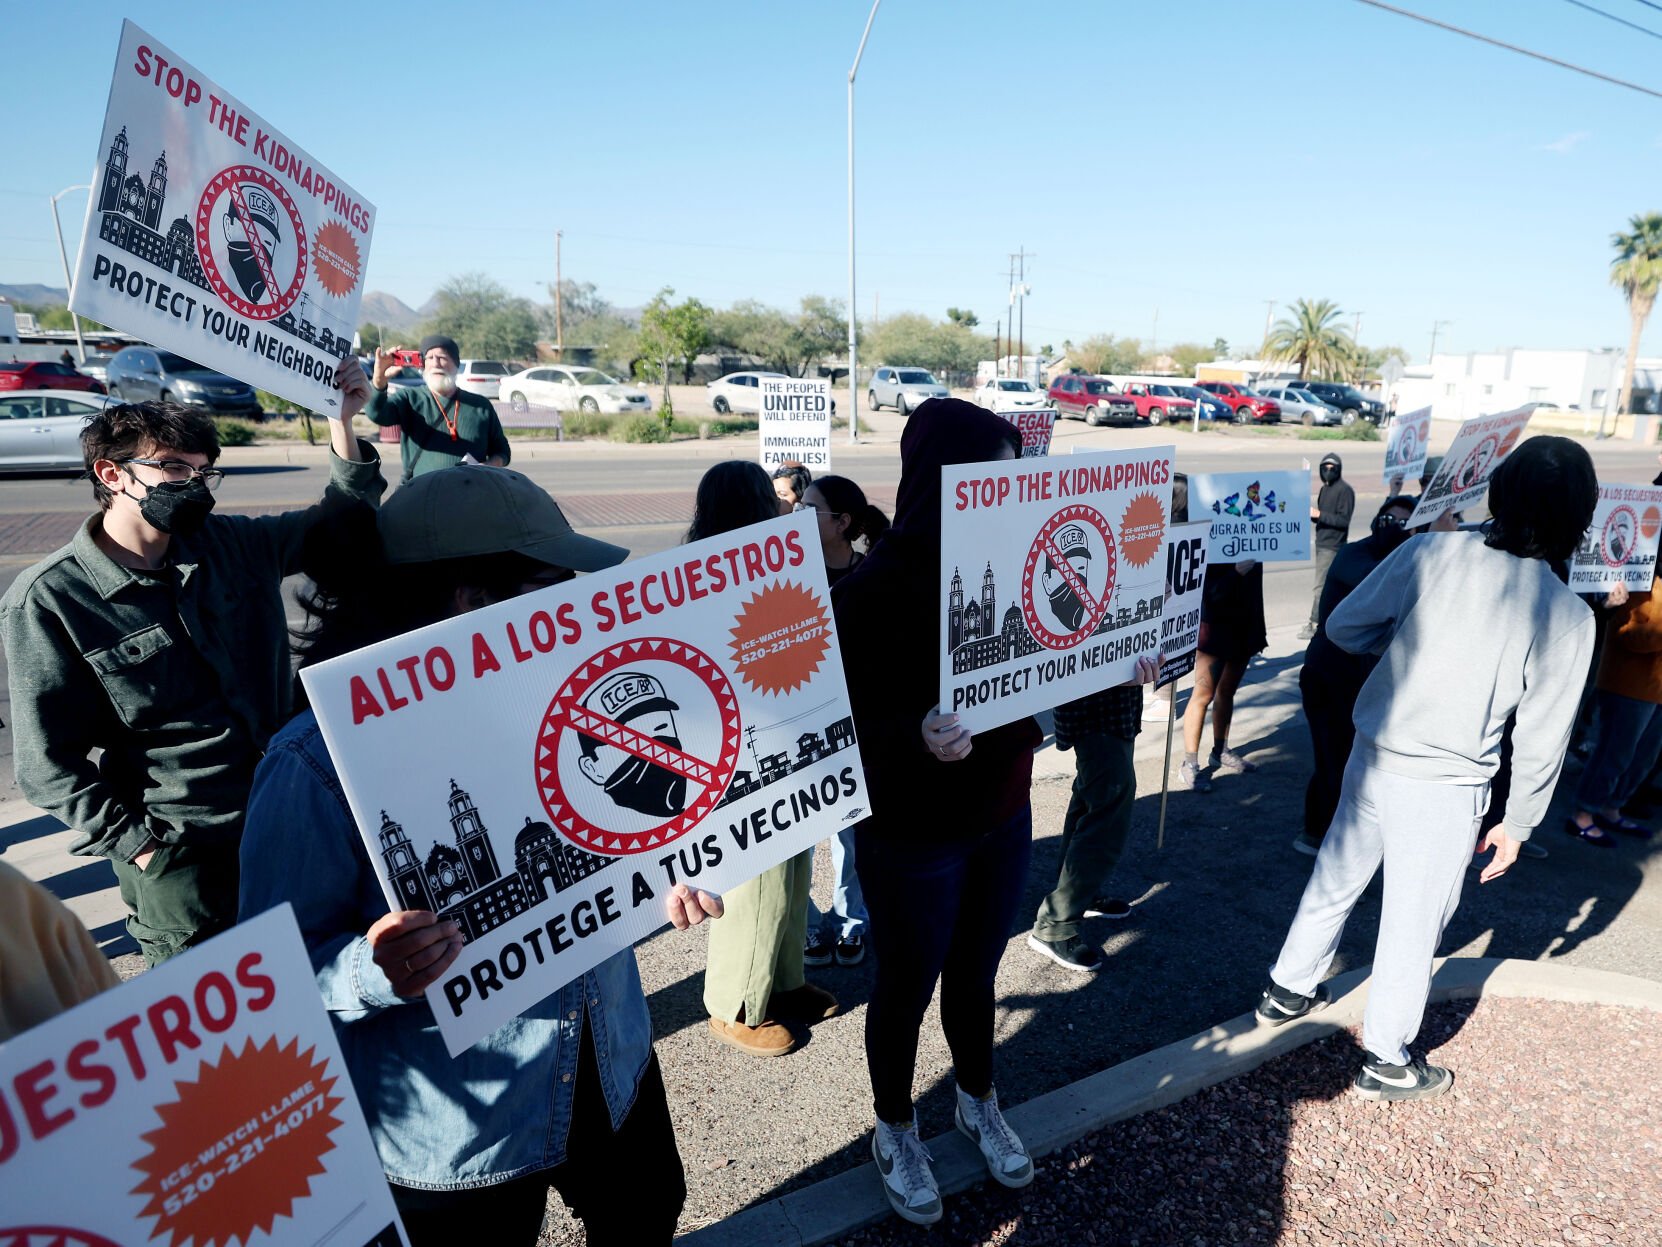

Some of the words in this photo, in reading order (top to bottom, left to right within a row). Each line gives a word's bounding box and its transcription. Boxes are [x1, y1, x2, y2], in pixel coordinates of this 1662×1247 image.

[134, 45, 201, 108] STOP
[209, 94, 250, 146] THE
[254, 128, 370, 234] KIDNAPPINGS
[93, 253, 196, 323] PROTECT
[202, 303, 249, 349] YOUR
[254, 333, 341, 390] NEIGHBORS
[763, 382, 784, 394] THE
[786, 383, 826, 394] PEOPLE
[764, 395, 826, 412] UNITED
[764, 411, 786, 422] WILL
[789, 411, 827, 422] DEFEND
[764, 436, 827, 448] IMMIGRANT
[764, 451, 827, 465] FAMILIES!
[955, 476, 1010, 512] STOP
[1016, 471, 1053, 503] THE
[1058, 459, 1170, 498] KIDNAPPINGS
[1609, 488, 1622, 499] LOS
[1124, 530, 1161, 543] 520-221-4077
[1251, 522, 1266, 534] NO
[1269, 522, 1282, 534] ES
[1286, 521, 1301, 533] UN
[1221, 536, 1278, 557] DELITO
[1572, 571, 1602, 583] PROTEGE
[1611, 571, 1621, 581] TUS
[1624, 571, 1651, 582] VECINOS
[351, 646, 456, 725] ALTO
[472, 632, 501, 679] A
[506, 603, 582, 663] LOS
[591, 529, 806, 633] SECUESTROS
[741, 627, 789, 651] ICE-WATCH
[790, 615, 819, 632] LLAME
[1176, 613, 1187, 634] OF
[1187, 608, 1200, 629] OUR
[741, 625, 823, 665] 520-221-4077
[953, 667, 1032, 713] PROTECT
[1037, 654, 1076, 687] YOUR
[1081, 628, 1158, 673] NEIGHBORS
[443, 887, 622, 1018] PROTEGE
[632, 872, 655, 908] A
[659, 834, 723, 887] TUS
[729, 767, 858, 851] VECINOS
[159, 1118, 260, 1192] ICE-WATCH
[261, 1080, 316, 1124] LLAME
[162, 1092, 328, 1218] 520-221-4077
